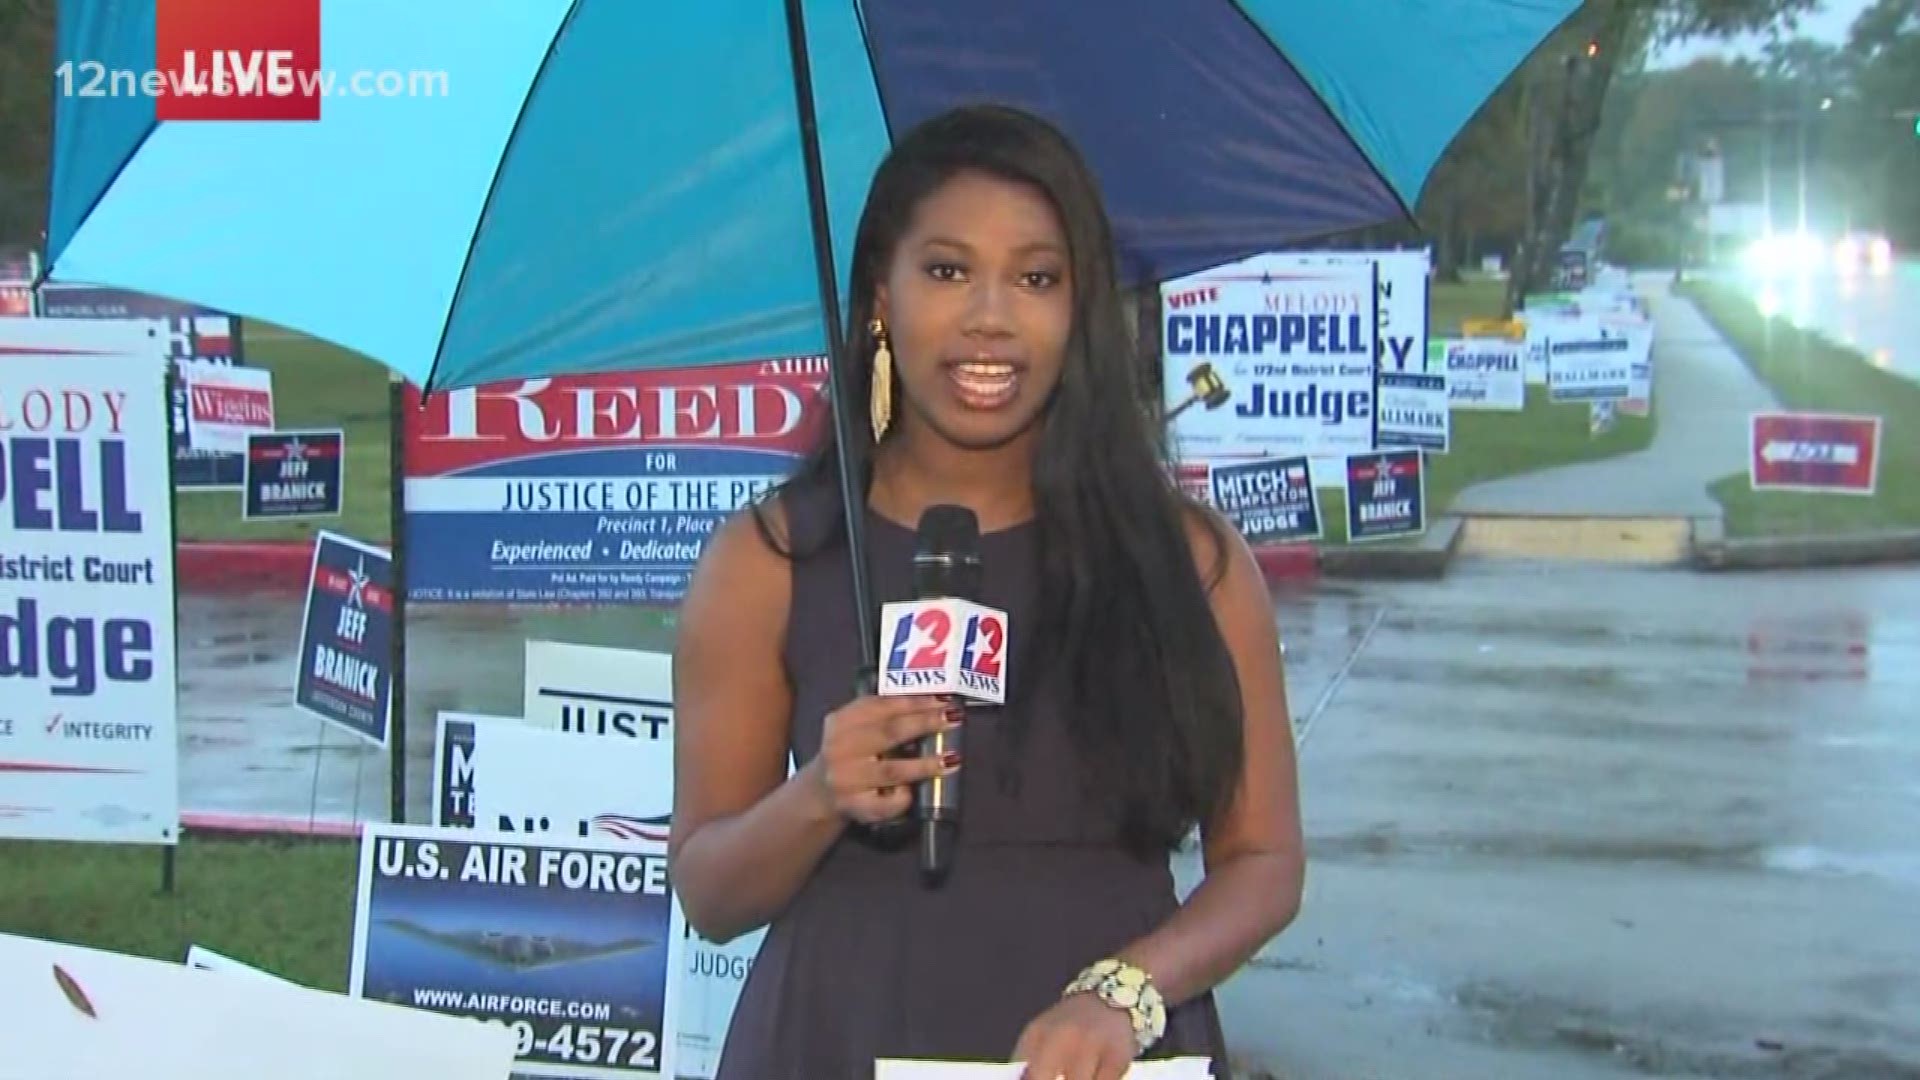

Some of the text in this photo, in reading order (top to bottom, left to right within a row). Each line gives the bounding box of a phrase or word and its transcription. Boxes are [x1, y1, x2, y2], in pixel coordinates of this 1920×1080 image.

[1168, 287, 1218, 309] VOTE
[1265, 294, 1360, 312] MELODY
[1167, 314, 1367, 354] CHAPPELL
[1292, 365, 1335, 376] District
[194, 388, 271, 423] Wiggins
[420, 379, 825, 441] REED
[1236, 384, 1369, 425] Judge
[279, 461, 308, 478] JEFF
[646, 453, 676, 471] FOR
[0, 437, 142, 532] ELL
[261, 481, 326, 501] BRANICK
[503, 481, 614, 511] JUSTICE
[626, 481, 657, 511] OF
[669, 481, 718, 510] THE
[1217, 469, 1287, 499] MITCH
[1221, 487, 1308, 511] TEMPLETON
[597, 515, 714, 537] Precinct 1, Place
[1243, 513, 1298, 535] JUDGE
[491, 539, 701, 564] Experienced Dedicated
[83, 556, 153, 584] Court
[337, 605, 367, 644] JEFF
[887, 610, 951, 669] 12
[959, 615, 1003, 677] 12
[314, 645, 378, 700] BRANICK
[887, 671, 946, 686] NEWS
[958, 671, 1000, 695] NEWS
[63, 721, 153, 741] INTEGRITY
[378, 838, 667, 895] U.S. AIR FORCE
[413, 989, 611, 1021] WWW.AIRFORCE.COM
